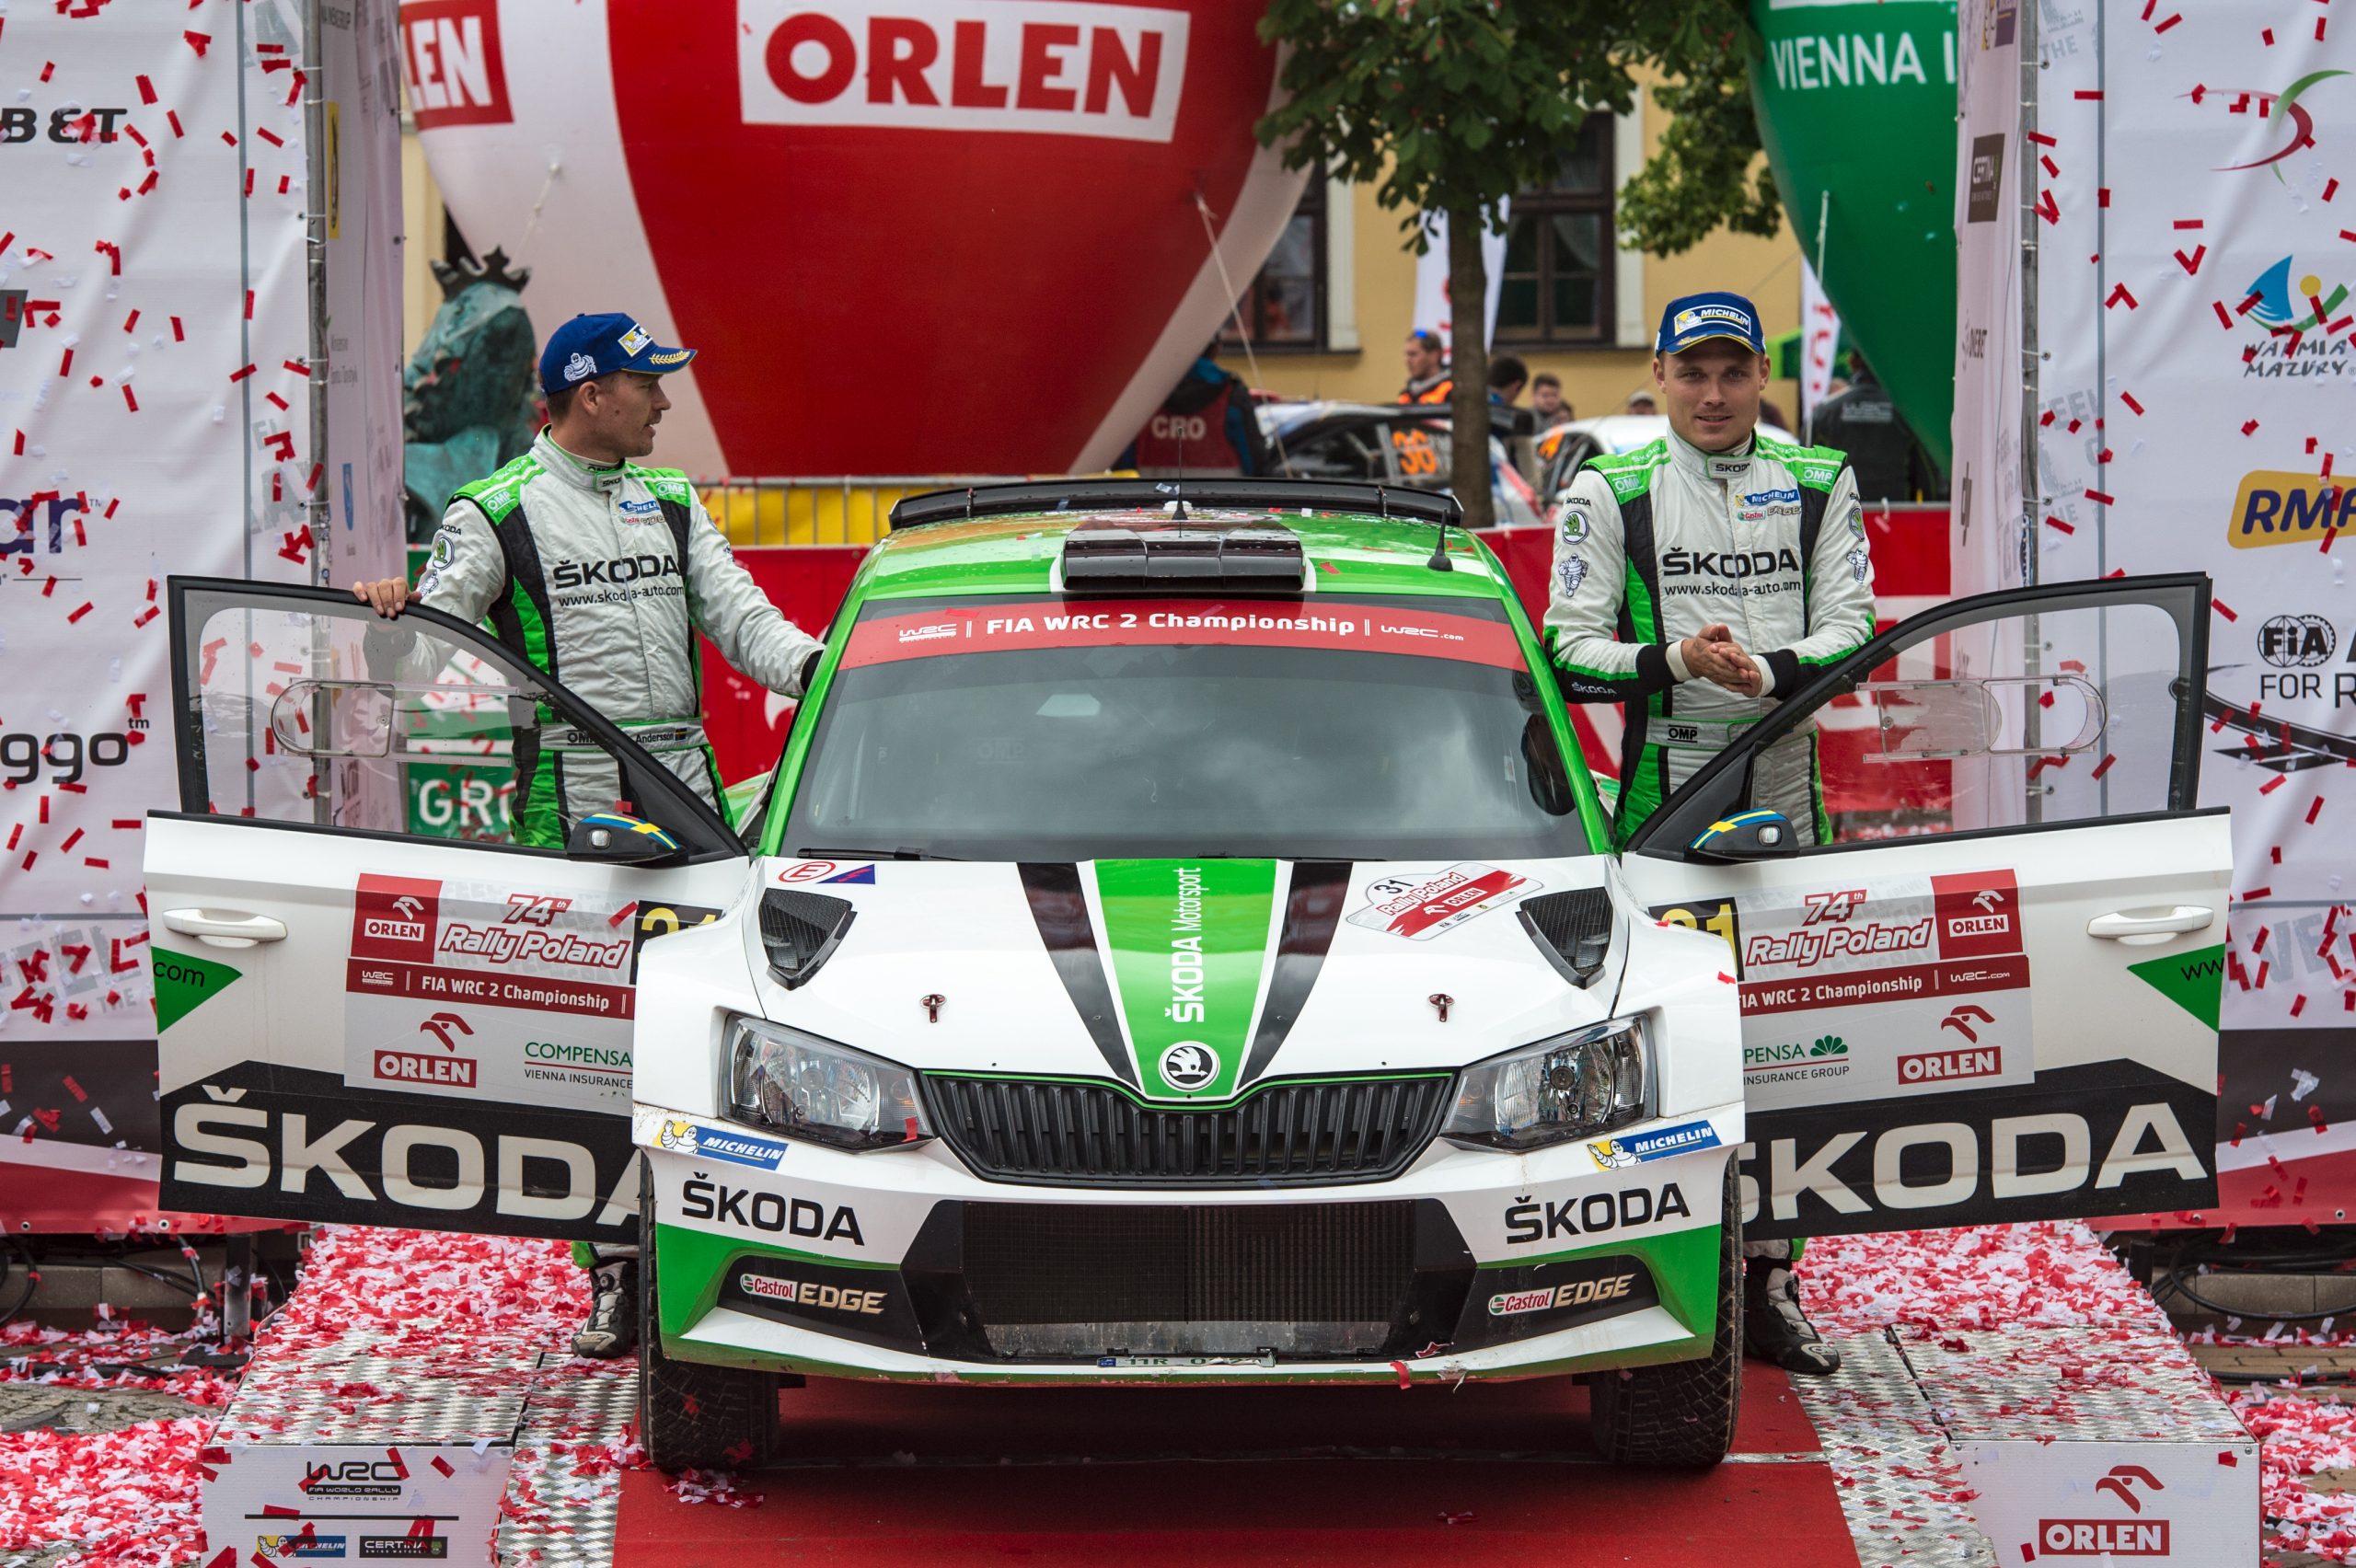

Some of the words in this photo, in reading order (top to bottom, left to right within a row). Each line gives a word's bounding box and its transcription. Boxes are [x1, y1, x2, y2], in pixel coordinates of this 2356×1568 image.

[765, 12, 1164, 119] ORLEN
[1770, 31, 1927, 90] VIENNA
[1701, 308, 1749, 326] MICHELIN
[2243, 339, 2347, 358] WAMIA
[2244, 360, 2349, 378] MAZURY
[1151, 415, 1206, 440] CRO
[1392, 429, 1437, 476] 36
[1804, 468, 1833, 481] OMP
[486, 490, 513, 511] OMP
[657, 483, 685, 496] OMP
[1751, 490, 1795, 502] MICHELIN
[553, 554, 681, 590] ŠKODA
[1662, 547, 1799, 578] ŠKODA
[899, 623, 957, 637] WRC
[987, 617, 1035, 634] FIA
[1044, 615, 1110, 631] WRC
[1120, 613, 1138, 628] 2
[1149, 612, 1356, 637] Championship
[1572, 681, 1617, 695] ŠKODA
[2260, 673, 2323, 700] FOR
[567, 732, 595, 744] OM
[1668, 727, 1698, 740] OMP
[1374, 879, 1414, 894] 31
[1376, 893, 1423, 916] Rally
[1410, 871, 1469, 904] Poland
[1448, 889, 1484, 905] ORLEN
[1172, 868, 1209, 932] Motorsport
[368, 921, 421, 939] ORLEN
[1952, 918, 2006, 934] ORLEN
[439, 923, 520, 963] Rally
[514, 930, 631, 969] Poland
[1745, 930, 1824, 968] Rally
[1822, 917, 1934, 959] Poland
[362, 971, 394, 980] WRC
[422, 975, 446, 992] FIA
[451, 980, 485, 997] WRC
[489, 982, 499, 997] 2
[504, 984, 609, 1012] Championship
[1165, 936, 1205, 1023] ŠKODA
[1761, 987, 1797, 1005] WRC
[1800, 986, 1811, 1002] 2
[1816, 975, 1923, 999] Championship
[525, 1041, 633, 1067] COMPENSA
[1902, 1051, 1996, 1080] ORLEN
[379, 1055, 470, 1084] ORLEN
[525, 1068, 566, 1083] VIENNA
[570, 1073, 633, 1090] INSURANCE
[1743, 1069, 1809, 1086] INSURANCE
[1811, 1066, 1850, 1080] GROUP
[702, 1136, 785, 1162] MICHELIN
[1634, 1125, 1715, 1156] MICHELIN
[682, 1172, 865, 1246] ŠKODA
[1505, 1182, 1692, 1245] ŠKODA
[754, 1276, 794, 1301] Castrol
[798, 1283, 888, 1315] EDGE
[1505, 1290, 1551, 1313] Castrol
[1553, 1274, 1636, 1309] EDGE
[306, 1460, 402, 1482] WRC
[364, 1486, 399, 1494] RALLY
[364, 1539, 428, 1550] CERTINA
[2045, 1523, 2162, 1552] ORLEN
